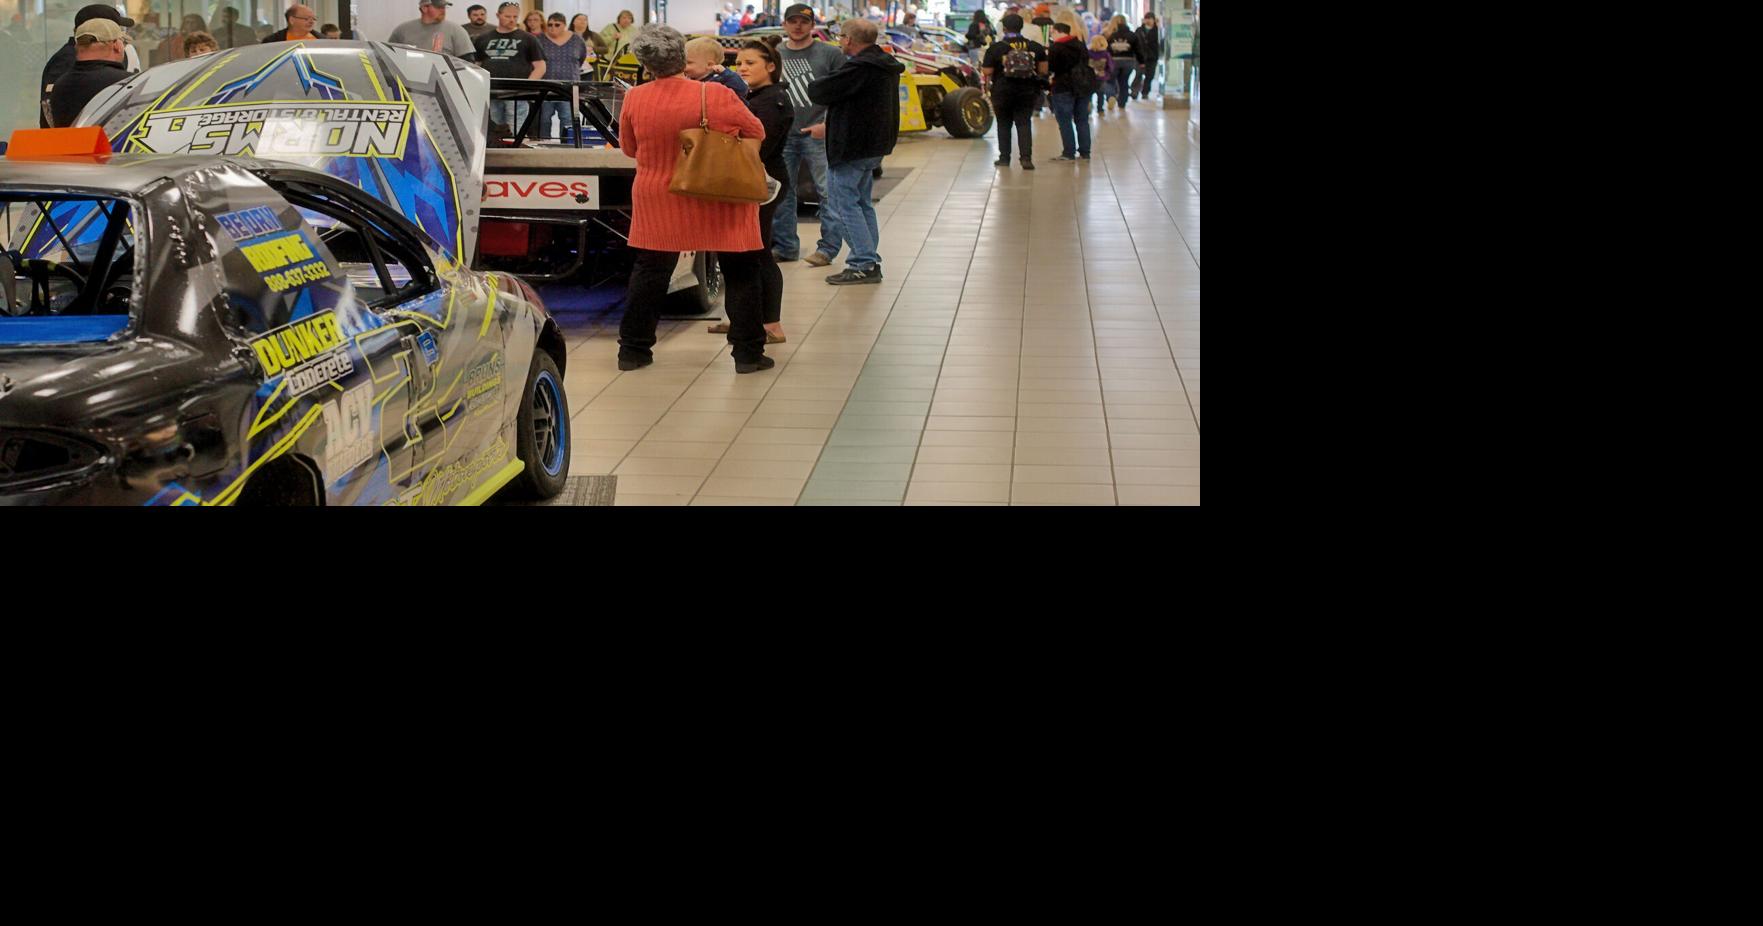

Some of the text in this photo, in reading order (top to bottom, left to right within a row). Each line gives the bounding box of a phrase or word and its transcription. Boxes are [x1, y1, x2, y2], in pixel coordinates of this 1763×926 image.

[487, 39, 521, 49] FOX
[322, 108, 406, 122] RENTAL
[215, 206, 281, 241] BE DRY
[252, 311, 341, 376] DUNKER
